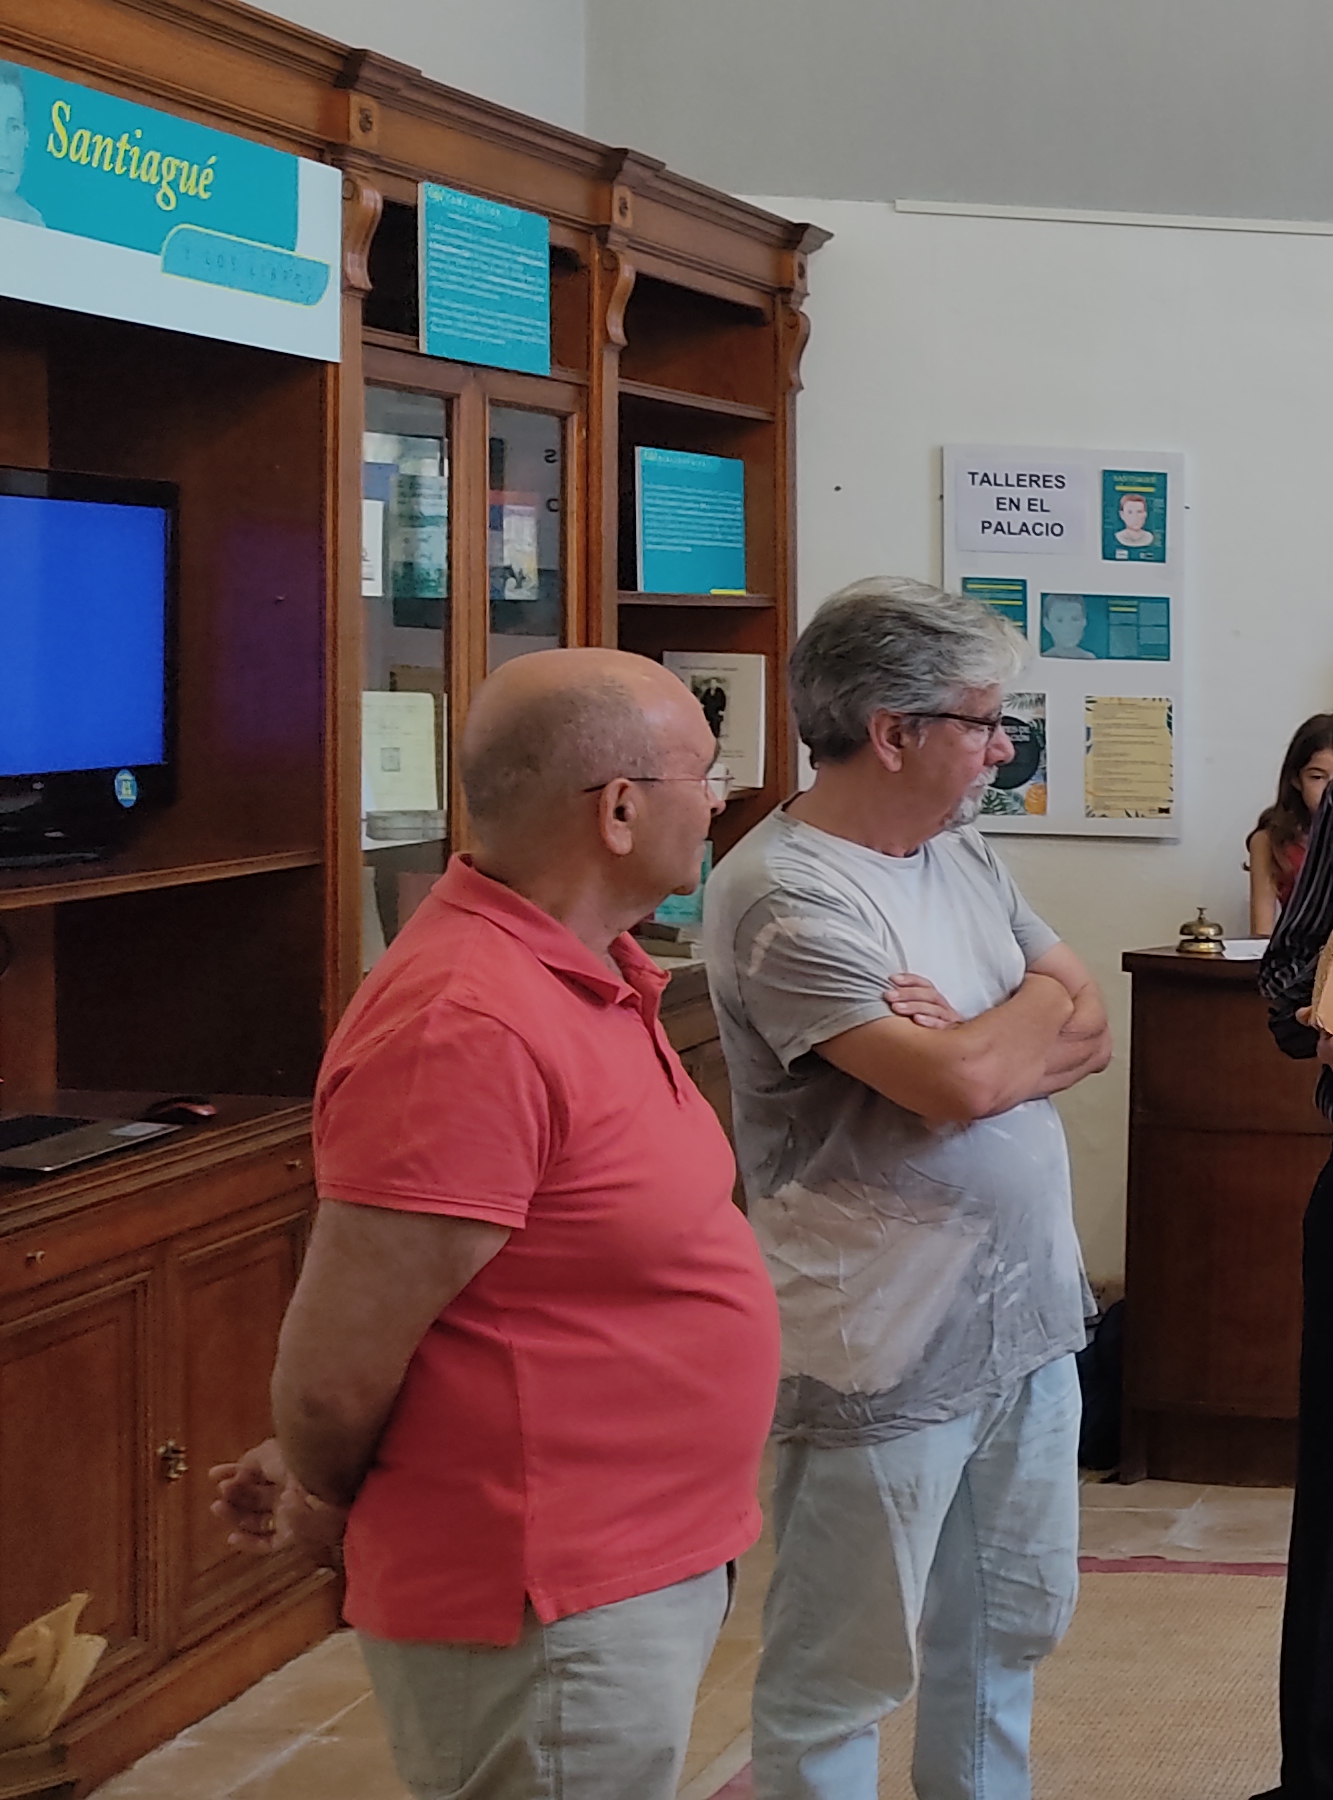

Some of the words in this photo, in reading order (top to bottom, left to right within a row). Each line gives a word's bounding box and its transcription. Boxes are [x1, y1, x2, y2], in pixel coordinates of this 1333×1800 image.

[46, 100, 218, 210] Santiagué
[968, 470, 1066, 490] TALLERES
[996, 496, 1021, 512] EN
[1027, 498, 1051, 513] EL
[980, 520, 1064, 538] PALACIO
